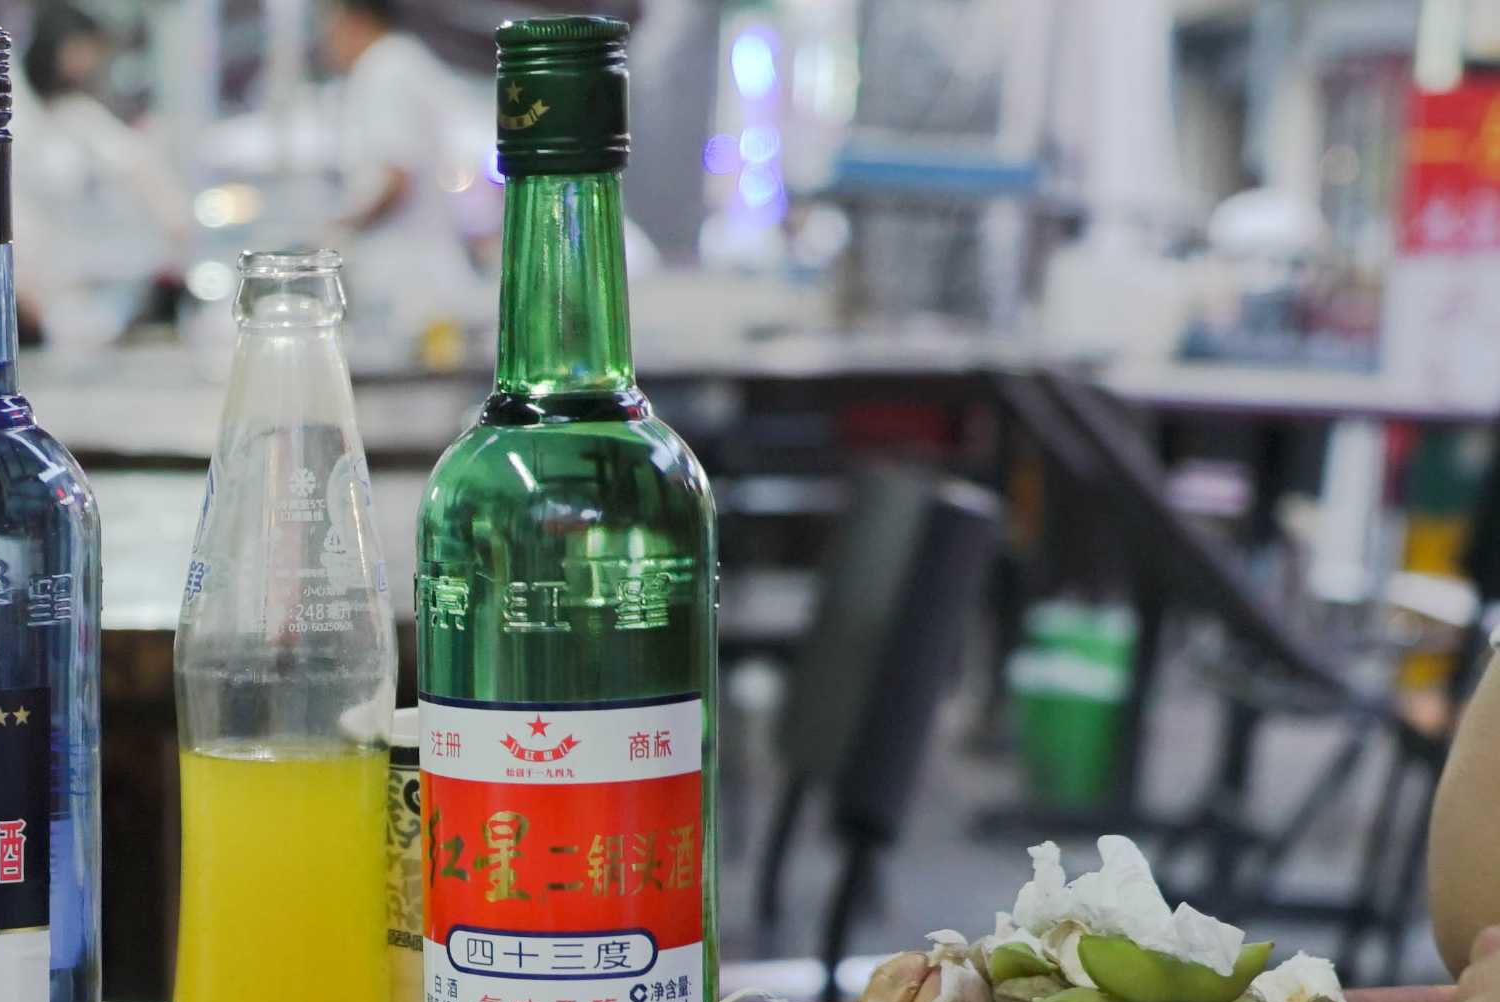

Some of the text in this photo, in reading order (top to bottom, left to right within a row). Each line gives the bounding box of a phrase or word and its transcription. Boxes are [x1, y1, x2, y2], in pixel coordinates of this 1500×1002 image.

[430, 730, 461, 758] 注册
[628, 729, 672, 761] 商标
[467, 938, 632, 970] 四十三度
